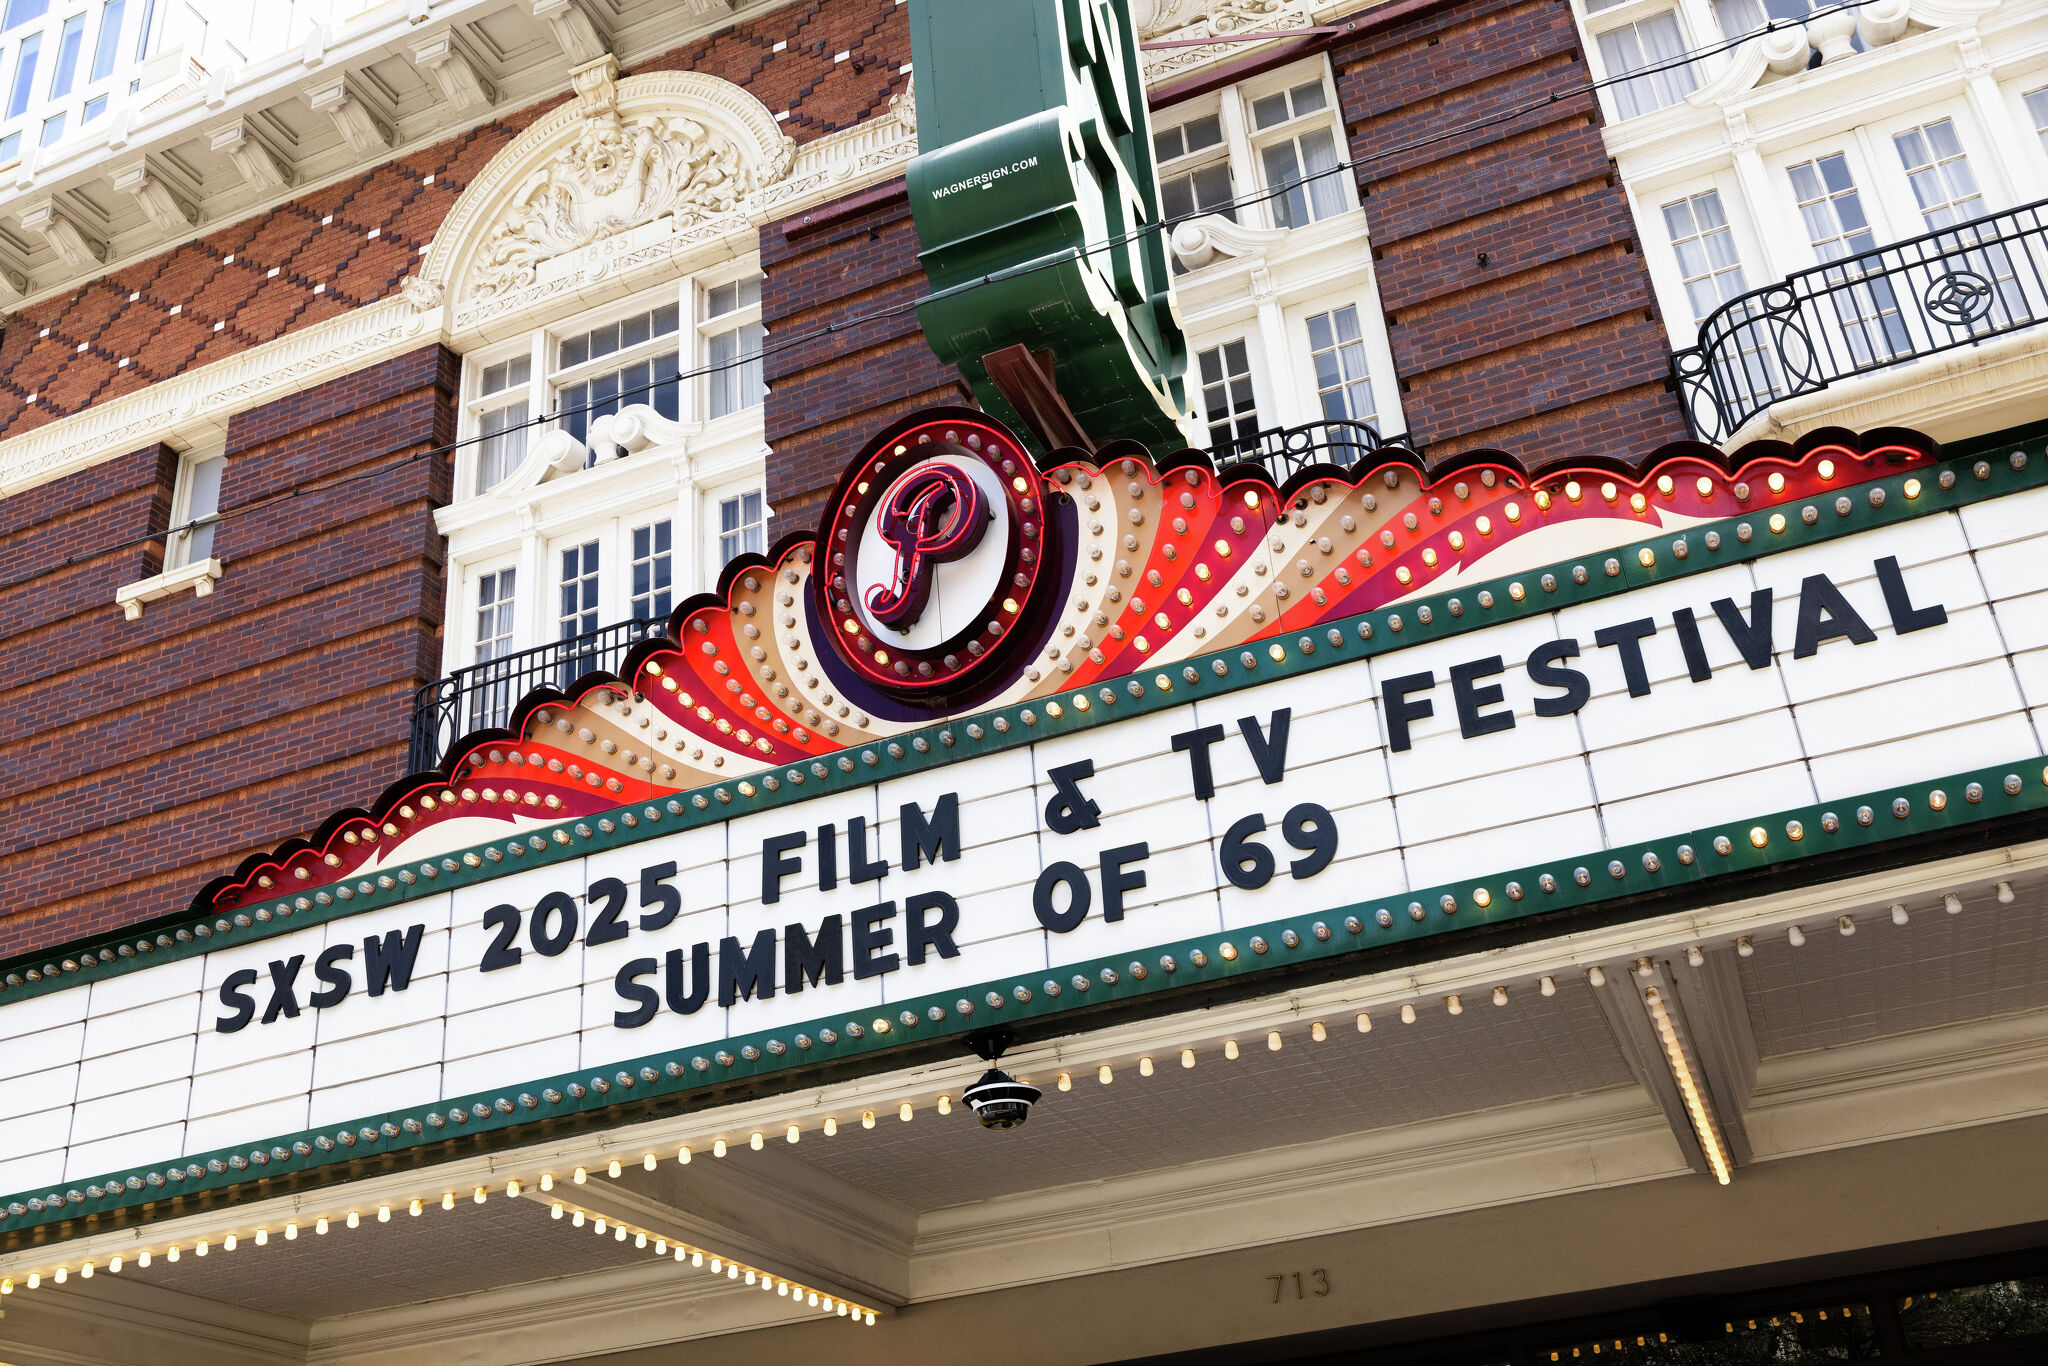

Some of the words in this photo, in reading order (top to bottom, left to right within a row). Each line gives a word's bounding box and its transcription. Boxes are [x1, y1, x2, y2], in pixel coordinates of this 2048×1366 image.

[931, 156, 1038, 200] WAGNERSIGN.COM
[578, 235, 628, 265] 1885
[216, 923, 426, 1034] SXSW
[479, 861, 682, 973] 2025
[761, 793, 962, 905] FILM
[1044, 758, 1102, 836] &
[1170, 707, 1291, 803] TV
[1380, 556, 1949, 752] FESTIVAL
[613, 891, 961, 1029] SUMMER
[1032, 841, 1150, 940] OF
[1219, 803, 1338, 891] 69
[1265, 1268, 1331, 1304] 713
